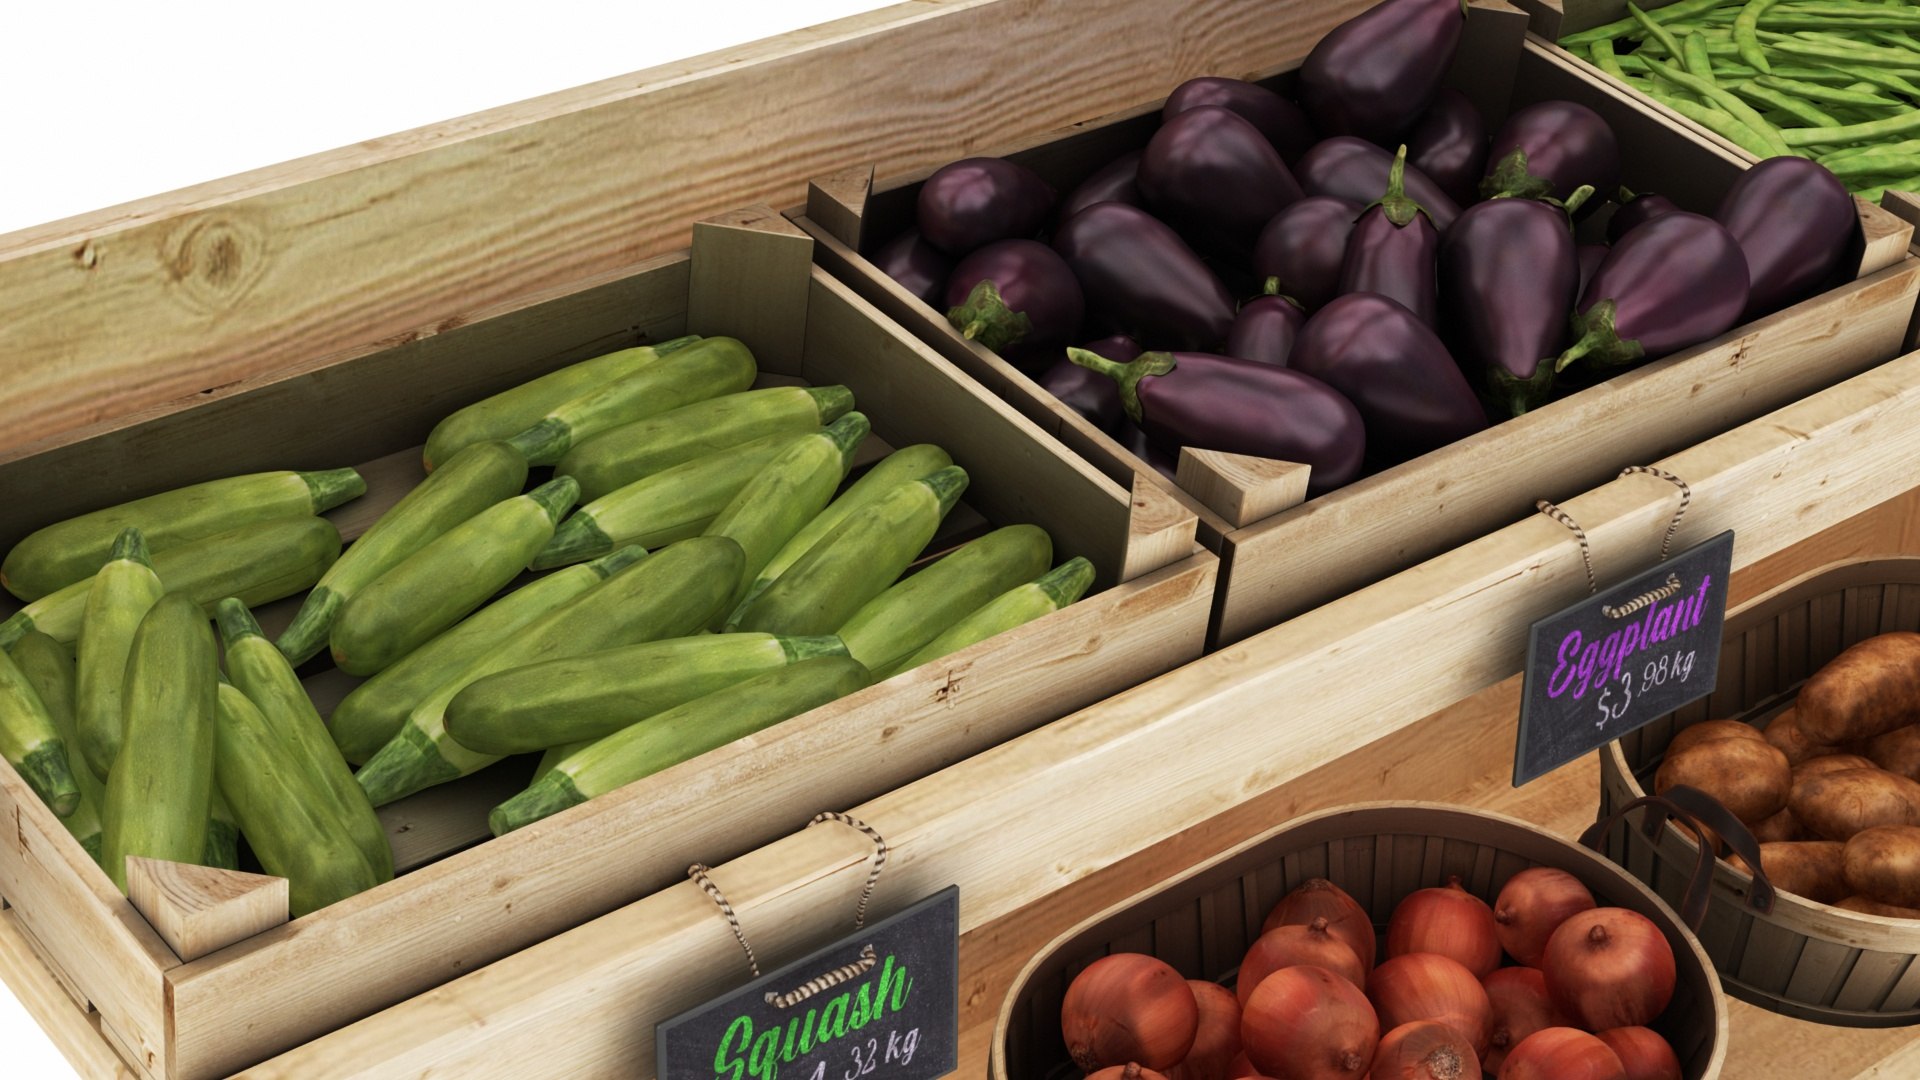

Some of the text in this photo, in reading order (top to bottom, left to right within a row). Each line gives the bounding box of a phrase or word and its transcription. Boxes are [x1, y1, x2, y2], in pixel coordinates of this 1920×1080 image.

[1547, 575, 1711, 700] Eggplant
[714, 955, 914, 1080] Squash
[884, 1027, 921, 1065] kg
